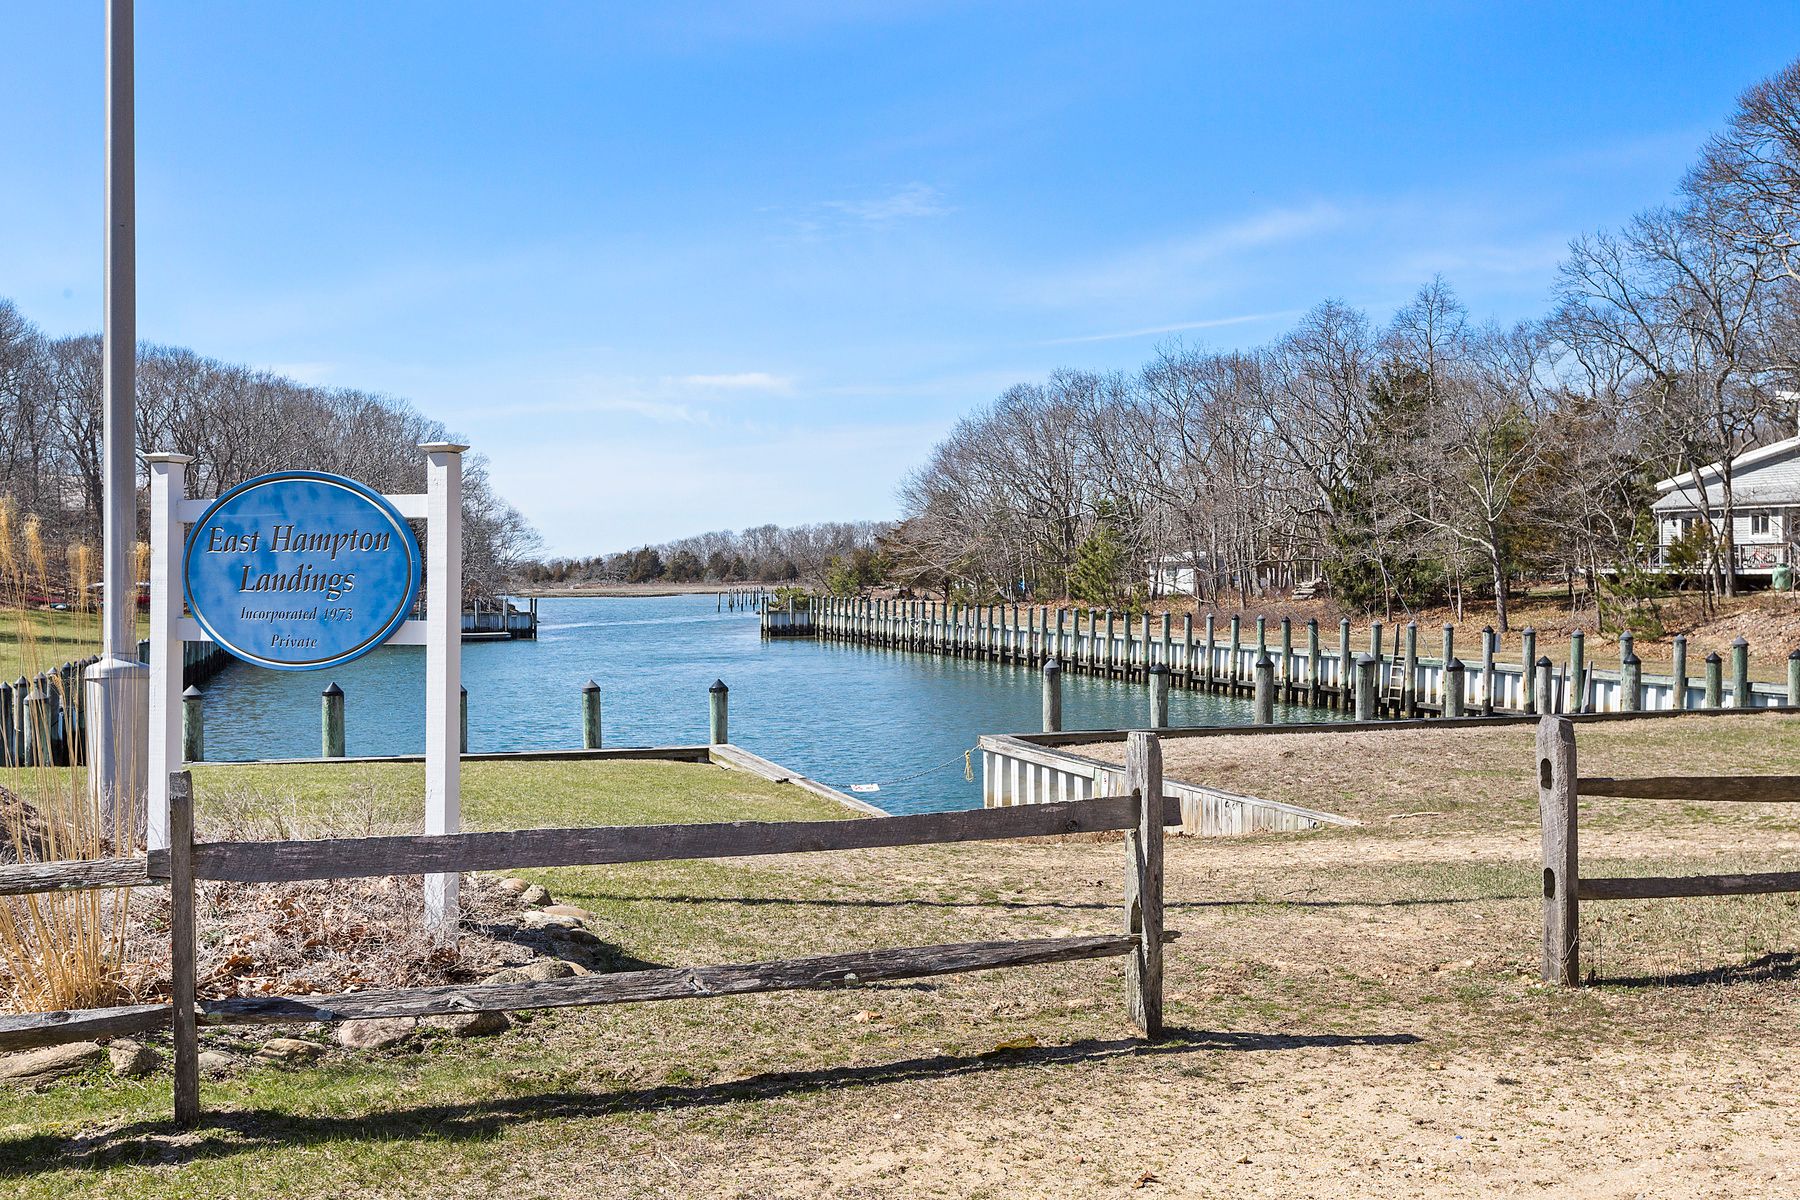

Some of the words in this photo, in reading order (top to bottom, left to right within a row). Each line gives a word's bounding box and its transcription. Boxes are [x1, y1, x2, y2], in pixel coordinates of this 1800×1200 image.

[206, 526, 261, 554] East
[269, 524, 391, 561] Hampton
[238, 563, 356, 602] Landings
[240, 606, 317, 624] Incorporated
[323, 607, 354, 622] 1973
[270, 634, 318, 649] Private
